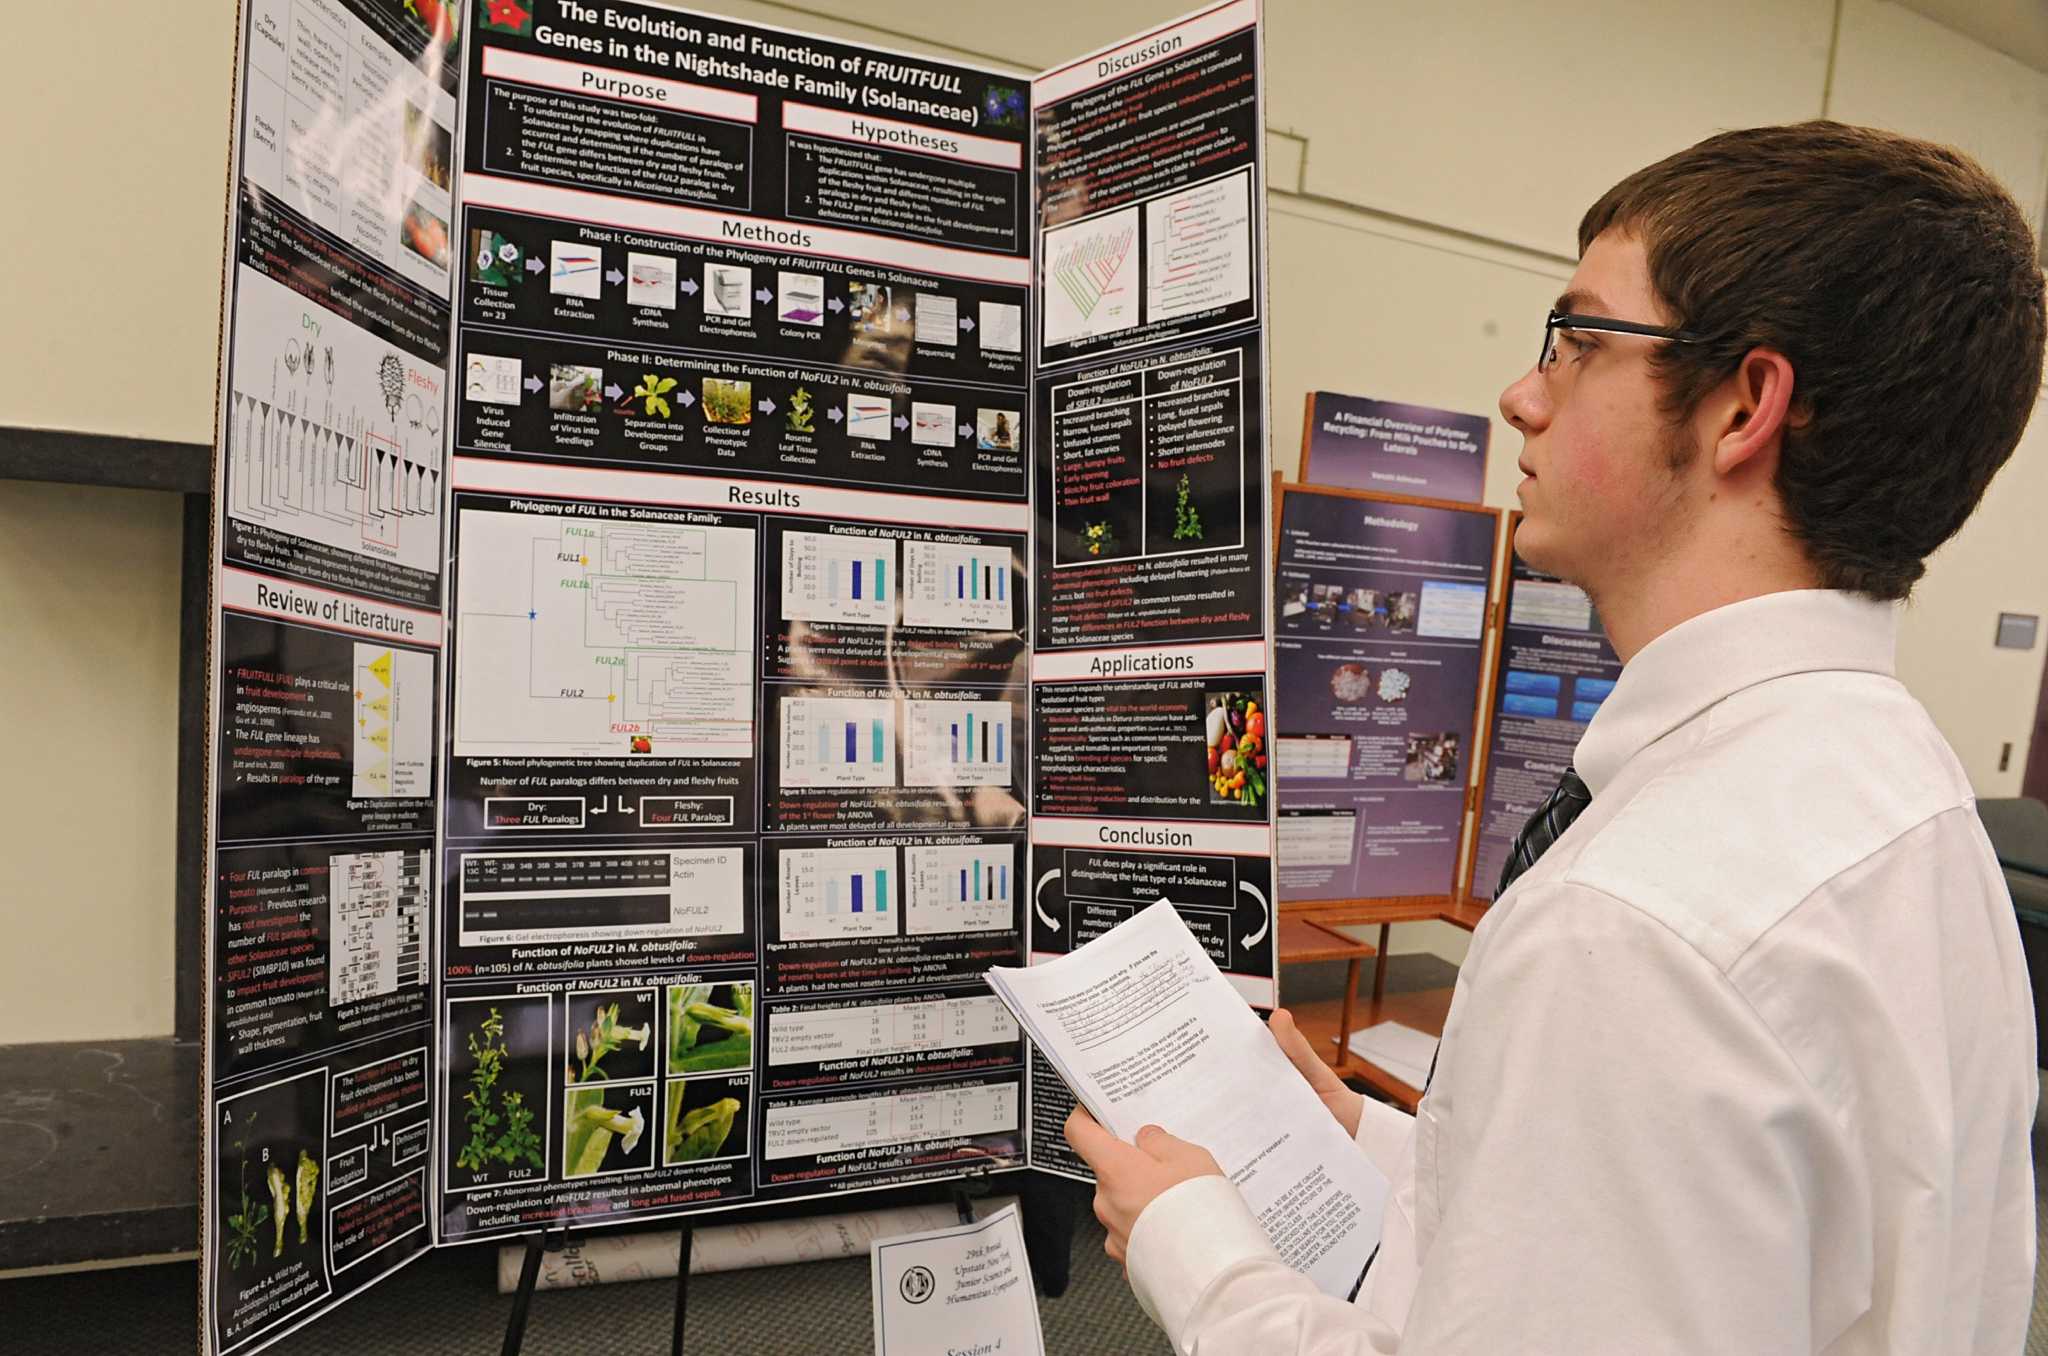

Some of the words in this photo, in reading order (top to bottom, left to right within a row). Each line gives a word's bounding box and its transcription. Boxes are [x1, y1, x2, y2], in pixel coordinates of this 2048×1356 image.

[555, 0, 597, 22] The
[604, 10, 701, 42] Evolution
[707, 33, 745, 51] and
[751, 38, 836, 67] Function
[840, 57, 861, 73] of
[864, 62, 961, 92] FRUITFULL
[1098, 37, 1181, 76] Discussion
[535, 26, 602, 52] Genes
[609, 38, 628, 57] in
[634, 45, 669, 65] the
[675, 53, 789, 86] Nightshade
[795, 75, 856, 102] Family
[862, 88, 978, 124] (Solanaceae)
[581, 72, 668, 104] Purpose
[851, 120, 959, 154] Hypotheses
[722, 221, 810, 246] Methods
[579, 228, 611, 241] Phase
[614, 233, 620, 242] I:
[623, 235, 690, 251] Construction
[693, 245, 704, 254] of
[706, 247, 723, 257] the
[726, 250, 777, 264] Phylogeny
[779, 256, 790, 265] of
[792, 258, 843, 272] FRUITFULL
[846, 265, 875, 277] Genes
[888, 272, 938, 287] Solanaceae
[482, 287, 508, 297] Tissue
[473, 298, 515, 308] Collection
[566, 298, 583, 306] RNA
[554, 308, 594, 318] Extraction
[302, 313, 321, 337] Dry
[607, 351, 639, 362] Phase
[642, 354, 651, 364] II:
[655, 356, 719, 372] Determining
[722, 363, 739, 372] the
[742, 365, 785, 377] Function
[788, 370, 798, 378] of
[800, 372, 838, 384] NoFUL2
[840, 376, 849, 385] in
[851, 378, 860, 387] N.
[864, 381, 911, 393] obtusifolia
[407, 369, 438, 397] Fleshy
[1158, 395, 1191, 407] Increased
[1194, 390, 1229, 401] branching
[482, 406, 504, 415] Virus
[1179, 406, 1198, 416] fused
[1201, 403, 1223, 413] sepals
[476, 417, 510, 427] Induced
[554, 413, 596, 422] Infiltration
[1335, 413, 1342, 421] A
[1344, 414, 1383, 427] Financial
[1384, 420, 1424, 432] Overview
[1426, 426, 1434, 434] of
[624, 418, 666, 430] Separation
[702, 426, 740, 434] Collection
[1158, 421, 1186, 432] Delayed
[1188, 417, 1222, 427] flowering
[481, 428, 504, 437] Gene
[624, 429, 683, 441] Developmental
[1158, 435, 1184, 444] Shorter
[1186, 426, 1234, 439] inflorescence
[1370, 429, 1392, 439] From
[555, 436, 593, 446] Seedlings
[705, 436, 747, 449] Phenotypic
[785, 433, 812, 445] Rosette
[474, 439, 511, 452] Silencing
[639, 442, 668, 451] Groups
[779, 444, 794, 455] Leaf
[796, 445, 817, 453] Tissue
[1158, 447, 1184, 456] Shorter
[1186, 441, 1225, 452] internodes
[717, 448, 735, 456] Data
[780, 454, 815, 463] Collection
[729, 486, 799, 507] Results
[510, 501, 563, 515] Phylogeny
[565, 505, 575, 513] of
[578, 505, 597, 515] FUL
[599, 507, 609, 516] in
[612, 507, 627, 517] the
[630, 509, 685, 521] Solanaceae
[687, 513, 722, 526] Family:
[558, 553, 580, 562] FUL1
[258, 584, 317, 614] Review
[323, 600, 338, 619] of
[343, 604, 413, 634] Literature
[1542, 635, 1601, 648] Discussion
[1090, 655, 1193, 676] Applications
[560, 688, 584, 697] FUL2
[612, 724, 640, 732] FUL2b
[236, 731, 248, 739] The
[250, 731, 264, 740] FUL
[265, 734, 282, 743] gene
[284, 733, 308, 744] lineage
[309, 734, 319, 743] has
[519, 777, 529, 785] of
[550, 778, 588, 786] paralogs
[657, 777, 671, 786] dry
[691, 777, 715, 785] fleshy
[528, 802, 546, 811] Dry:
[674, 801, 703, 810] Fleshy:
[542, 815, 579, 825] Paralogs
[691, 813, 725, 823] Paralogs
[1099, 827, 1192, 845] Conclusion
[1121, 861, 1136, 869] play
[1143, 863, 1181, 871] significant
[512, 948, 557, 957] Function
[560, 947, 571, 955] of
[574, 945, 613, 954] NoFUL2
[642, 941, 697, 951] obtusifolia:
[729, 1077, 749, 1086] FUL2
[630, 1087, 652, 1096] FUL2
[224, 1111, 232, 1124] A
[262, 1149, 269, 1162] B
[472, 1173, 488, 1182] WT
[509, 1169, 531, 1177] FUL2
